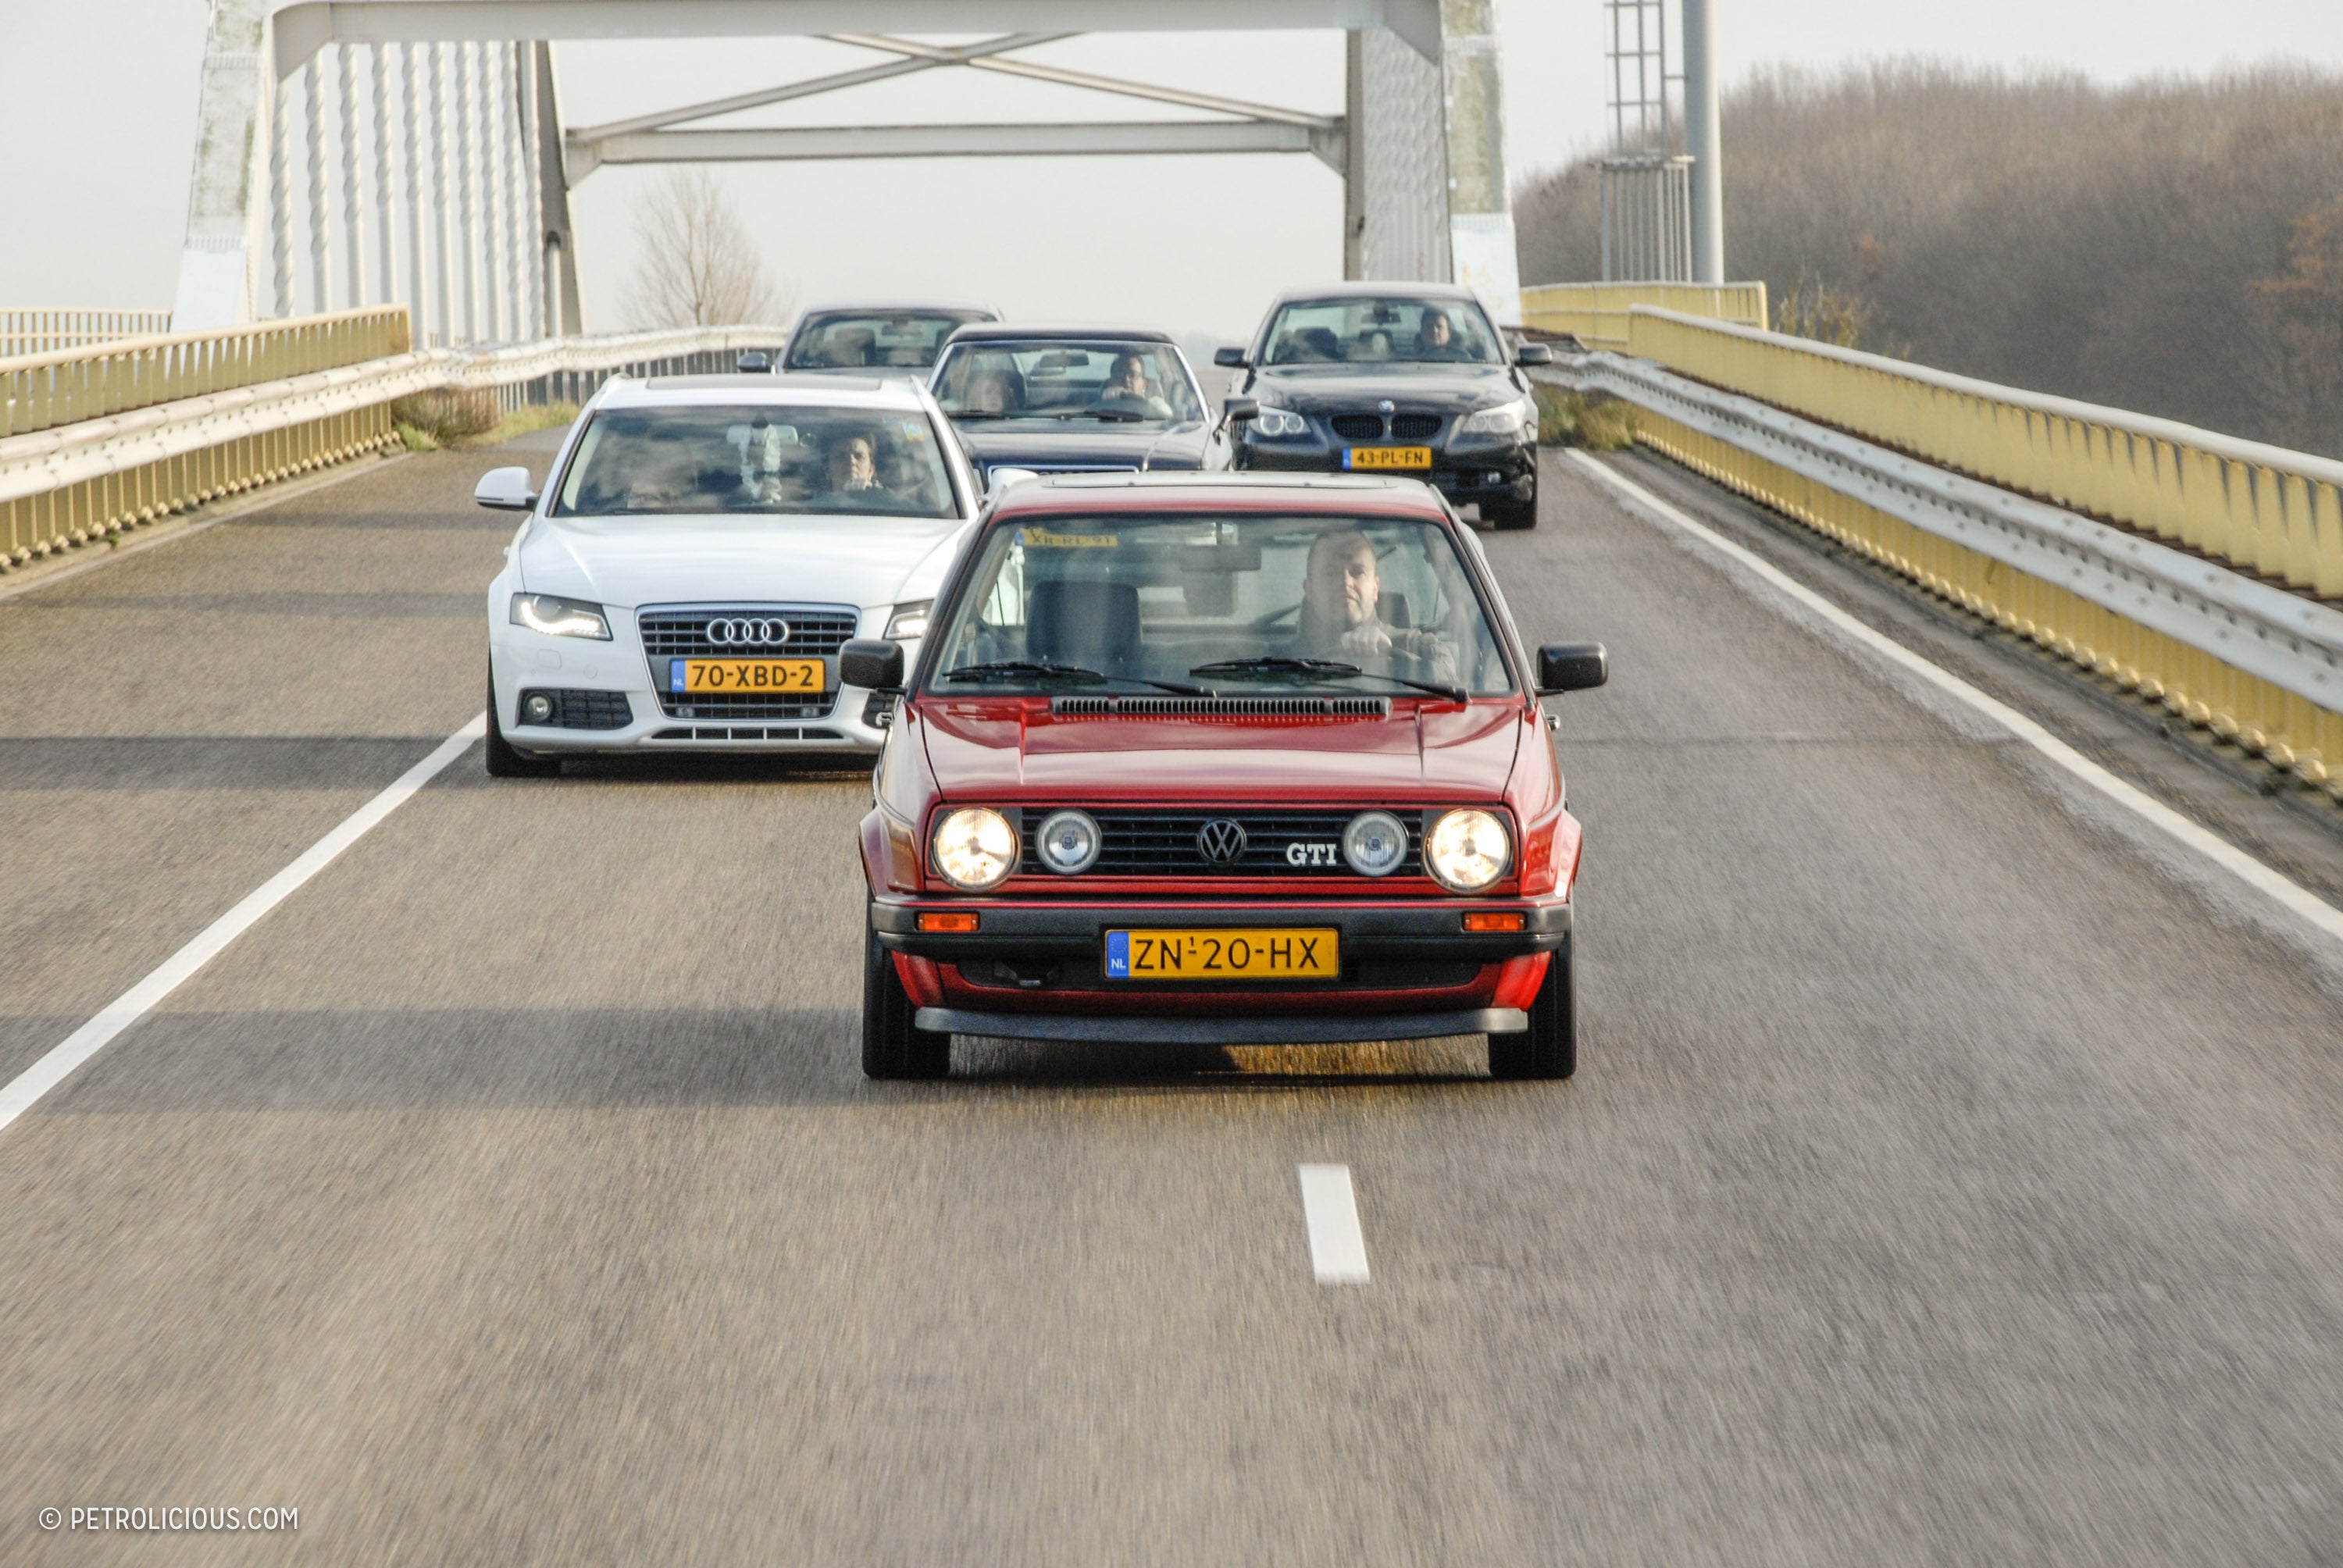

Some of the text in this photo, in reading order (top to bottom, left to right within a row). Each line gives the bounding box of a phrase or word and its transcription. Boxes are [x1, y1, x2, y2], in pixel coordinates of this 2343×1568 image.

[1357, 450, 1423, 464] 43-PL-FN
[692, 665, 813, 686] 70-XBD-2
[1287, 842, 1337, 867] GTI
[1111, 958, 1126, 970] NL
